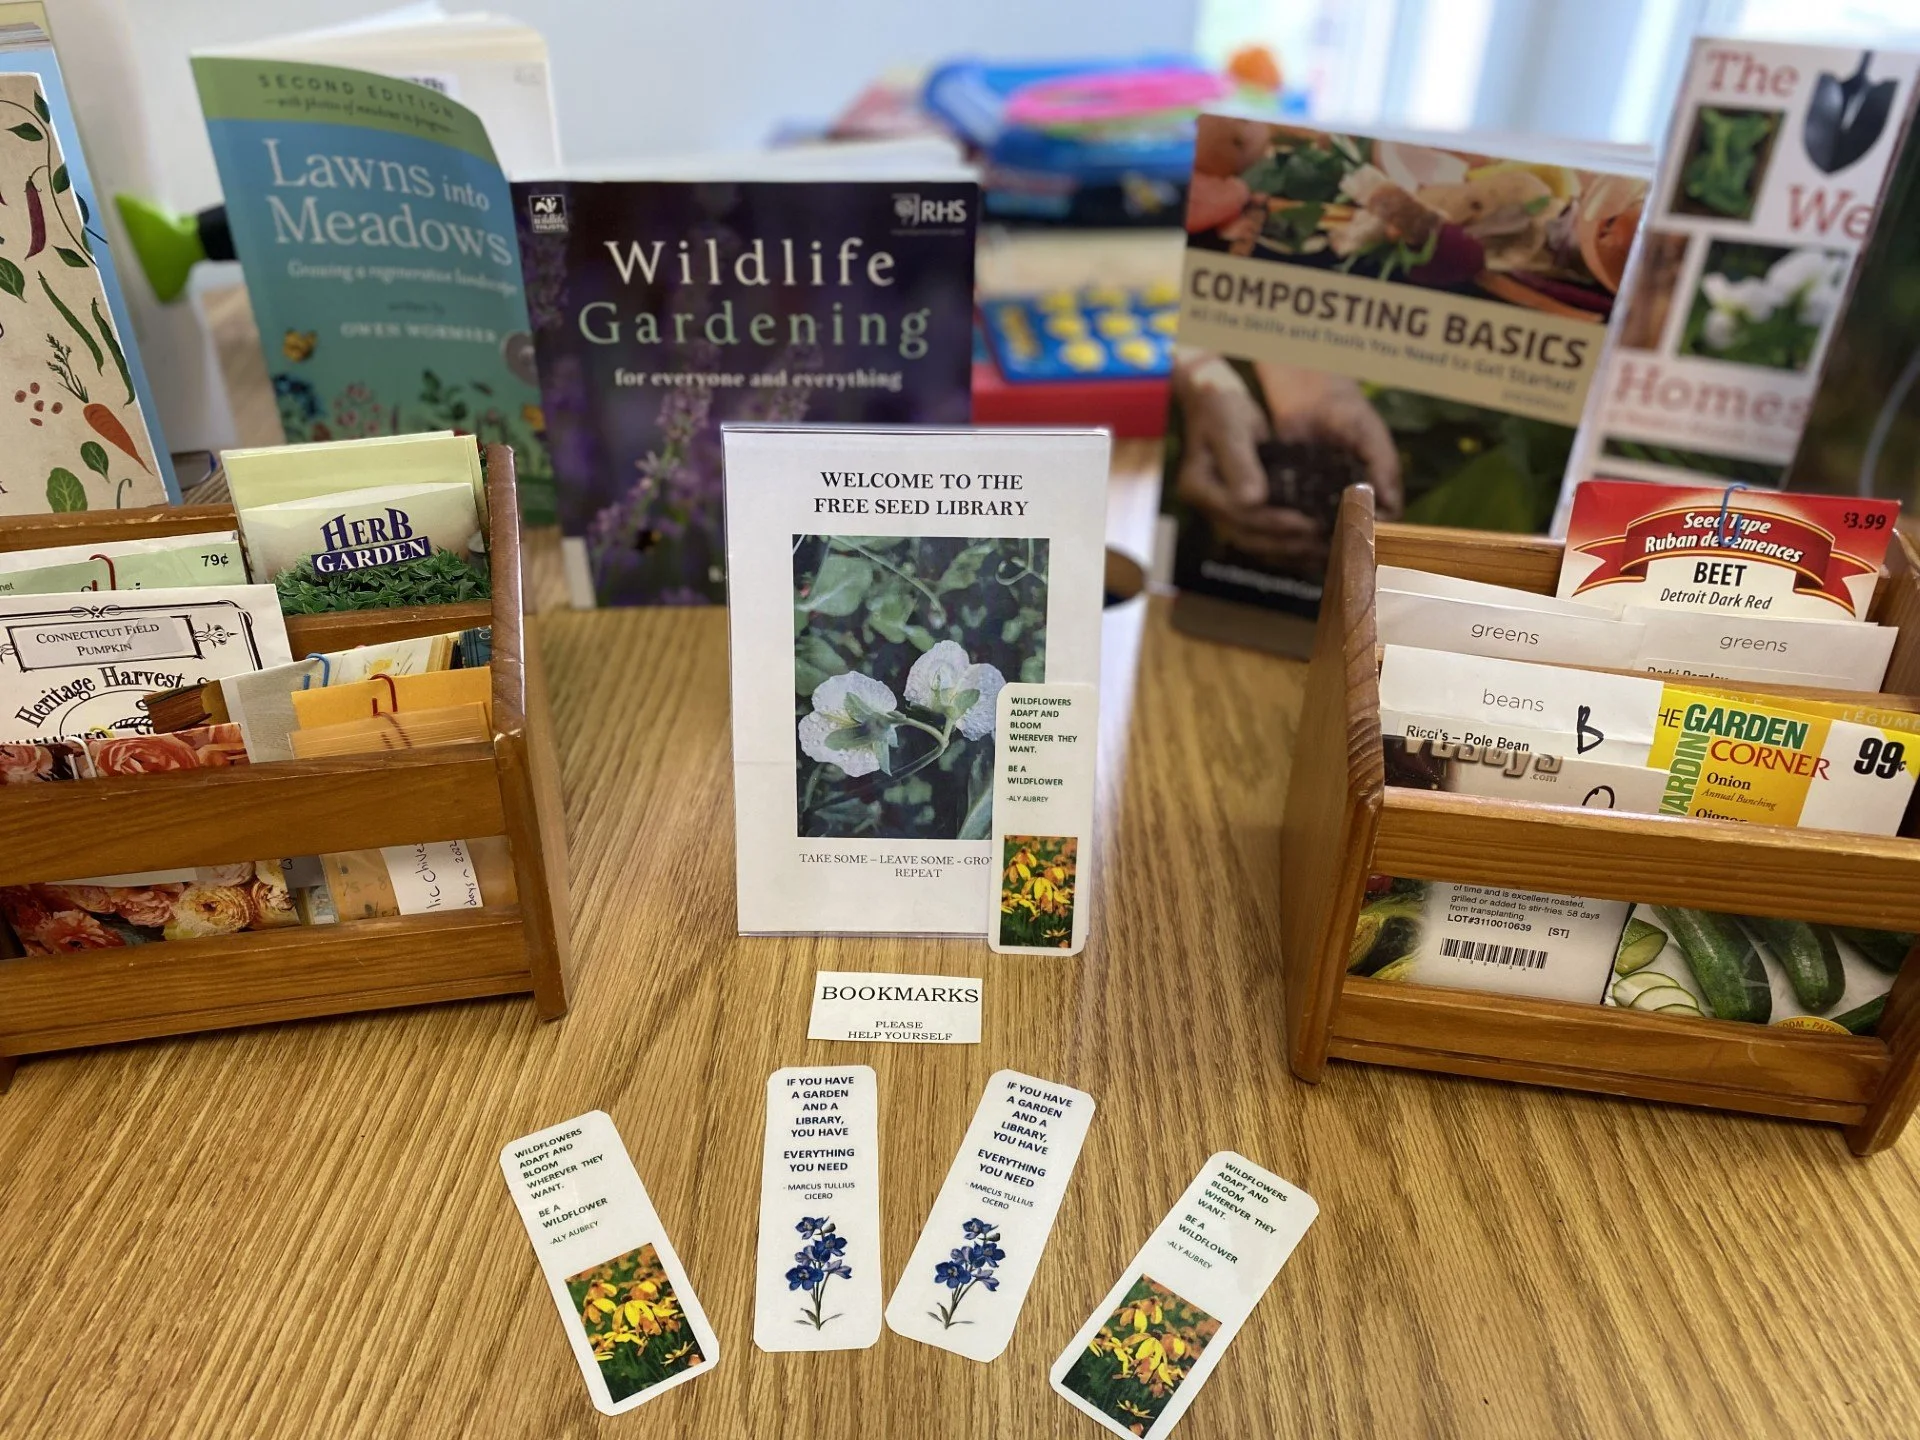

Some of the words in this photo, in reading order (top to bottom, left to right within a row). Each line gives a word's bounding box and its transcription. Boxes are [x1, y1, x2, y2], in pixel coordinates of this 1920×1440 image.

[1706, 51, 1799, 96] The
[259, 74, 354, 95] SECOND
[367, 85, 454, 120] EDITION
[263, 137, 435, 197] Lawns
[443, 176, 489, 211] into
[922, 199, 967, 224] RHS
[266, 196, 512, 266] Meadows
[604, 238, 895, 286] Wildlife
[578, 301, 930, 358] Gardening
[1190, 269, 1429, 338] COMPOSTING
[1442, 312, 1588, 369] BASICS
[614, 368, 645, 387] for
[652, 371, 745, 391] everyone
[750, 369, 787, 388] and
[793, 370, 902, 392] everything
[821, 472, 934, 489] WELCOME
[940, 474, 971, 489] TO
[978, 475, 1023, 490] THE
[814, 498, 869, 514] FREE
[875, 499, 929, 515] SEED
[936, 501, 1029, 516] LIBRARY
[320, 507, 413, 553] HERB
[1684, 512, 1723, 529] Seed
[1843, 512, 1887, 530] $3.99
[1645, 534, 1698, 553] Ruban
[1700, 534, 1719, 547] de
[201, 554, 229, 567] 79¢
[316, 538, 428, 574] GARDEN
[1693, 562, 1747, 587] BEET
[1660, 588, 1707, 604] Detroit
[1710, 591, 1742, 607] Dark
[1744, 594, 1773, 610] Red
[36, 628, 123, 645] CONNECTICUT
[126, 623, 160, 636] FIELD
[1471, 623, 1540, 645] greens
[1719, 635, 1788, 653] greens
[76, 642, 133, 656] PUMPKIN
[15, 676, 97, 728] Heritage
[97, 666, 186, 689] Harvest
[1011, 697, 1071, 706] WILDFLOWERS
[1482, 688, 1545, 712] beans
[1010, 709, 1039, 717] ADAPT
[1040, 710, 1059, 718] AND
[1406, 724, 1449, 741] Ricci's
[1464, 732, 1493, 746] Pole
[1497, 737, 1530, 751] Bean
[1576, 704, 1604, 755] B
[1658, 707, 1683, 728] HE
[1683, 703, 1809, 750] GARDEN
[1009, 734, 1054, 742] WHEREVER
[1710, 739, 1830, 781] CORNER
[1007, 777, 1063, 786] WILDFLOWER
[1529, 772, 1557, 783] .com
[1706, 772, 1751, 790] Onion
[1701, 789, 1734, 803] Annual
[1736, 793, 1777, 811] Bunching
[799, 853, 832, 864] TAKE
[834, 854, 868, 864] SOME
[880, 855, 918, 865] LEAVE
[920, 856, 954, 865] SOME
[964, 856, 992, 866] GRO
[894, 868, 942, 878] REPEAT
[1464, 886, 1482, 894] time
[1484, 888, 1500, 897] and
[1511, 892, 1549, 904] excellent
[1449, 904, 1468, 912] from
[1451, 894, 1477, 904] grilled
[1490, 900, 1516, 909] added
[1567, 909, 1578, 917] 58
[1580, 911, 1600, 920] days
[1447, 914, 1532, 931] LOT#3110010639
[1548, 927, 1570, 938] [ST]
[822, 986, 979, 1003] BOOKMARKS
[876, 1020, 923, 1029] PLEASE
[848, 1031, 882, 1040] HELP
[884, 1032, 953, 1041] YOURSELF
[803, 1090, 848, 1098] GARDEN
[1007, 1081, 1017, 1089] IF
[1019, 1085, 1041, 1097] YOU
[1043, 1093, 1073, 1107] HAVE
[802, 1103, 827, 1111] AND
[1006, 1096, 1014, 1104] A
[1018, 1099, 1062, 1118] GARDEN
[1012, 1110, 1037, 1123] AND
[796, 1116, 844, 1125] LIBRARY,
[791, 1129, 814, 1137] YOU
[818, 1128, 848, 1136] HAVE
[993, 1131, 1016, 1144] YOU
[1018, 1140, 1048, 1155] HAVE
[1001, 1121, 1048, 1143] LIBRARY,
[514, 1128, 582, 1159] WILDFLOWERS
[784, 1148, 854, 1159] EVERYTHING
[520, 1152, 550, 1169] ADAPT
[553, 1143, 573, 1156] AND
[977, 1149, 1047, 1177] EVERYTHING
[523, 1161, 558, 1179] BLOOM
[527, 1165, 578, 1188] WHEREVER
[581, 1154, 604, 1168] THEY
[790, 1164, 814, 1172] YOU
[818, 1163, 848, 1171] NEED
[979, 1164, 1002, 1177] YOU
[1004, 1172, 1034, 1188] NEED
[531, 1184, 564, 1200] WANT.
[1211, 1181, 1245, 1203] BLOOM
[1218, 1172, 1247, 1191] ADAPT
[1247, 1190, 1269, 1204] AND
[1225, 1163, 1288, 1202] WILDFLOWERS
[969, 1182, 1002, 1197] MARCUS
[1004, 1193, 1034, 1207] TULLIUS
[981, 1197, 1009, 1210] CICERO
[538, 1208, 550, 1218] BE
[553, 1204, 560, 1212] A
[542, 1198, 608, 1228] WILDFLOWER
[1198, 1199, 1226, 1220] WANT.
[1204, 1189, 1251, 1220] WHEREVER
[1255, 1218, 1276, 1234] THEY
[568, 1221, 598, 1237] AUBREY
[1185, 1214, 1197, 1225] BE
[1198, 1222, 1205, 1230] A
[1178, 1224, 1238, 1264] WILDFLOWER
[1183, 1250, 1212, 1269] AUBREY
